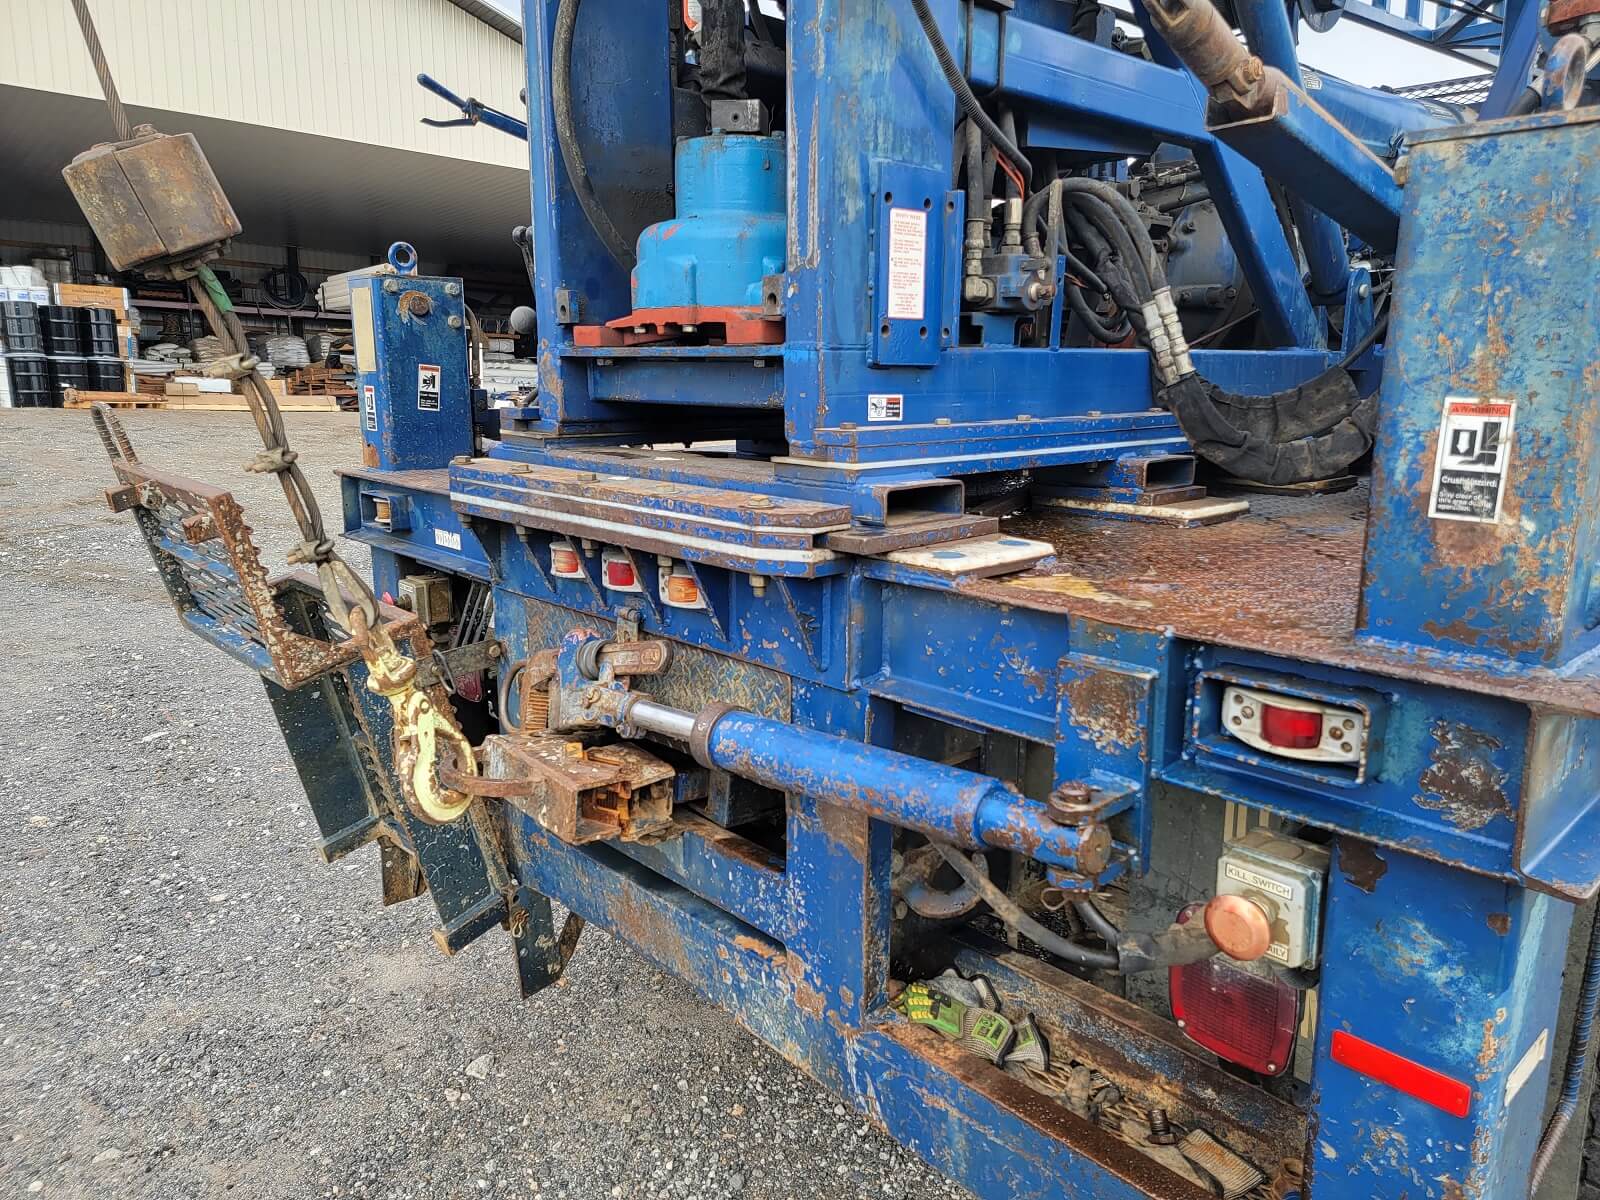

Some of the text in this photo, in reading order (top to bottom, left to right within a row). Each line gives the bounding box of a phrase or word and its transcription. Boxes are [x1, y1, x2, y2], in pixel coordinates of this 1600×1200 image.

[1460, 405, 1507, 415] WARNING
[1228, 866, 1290, 896] KILL SWITCH
